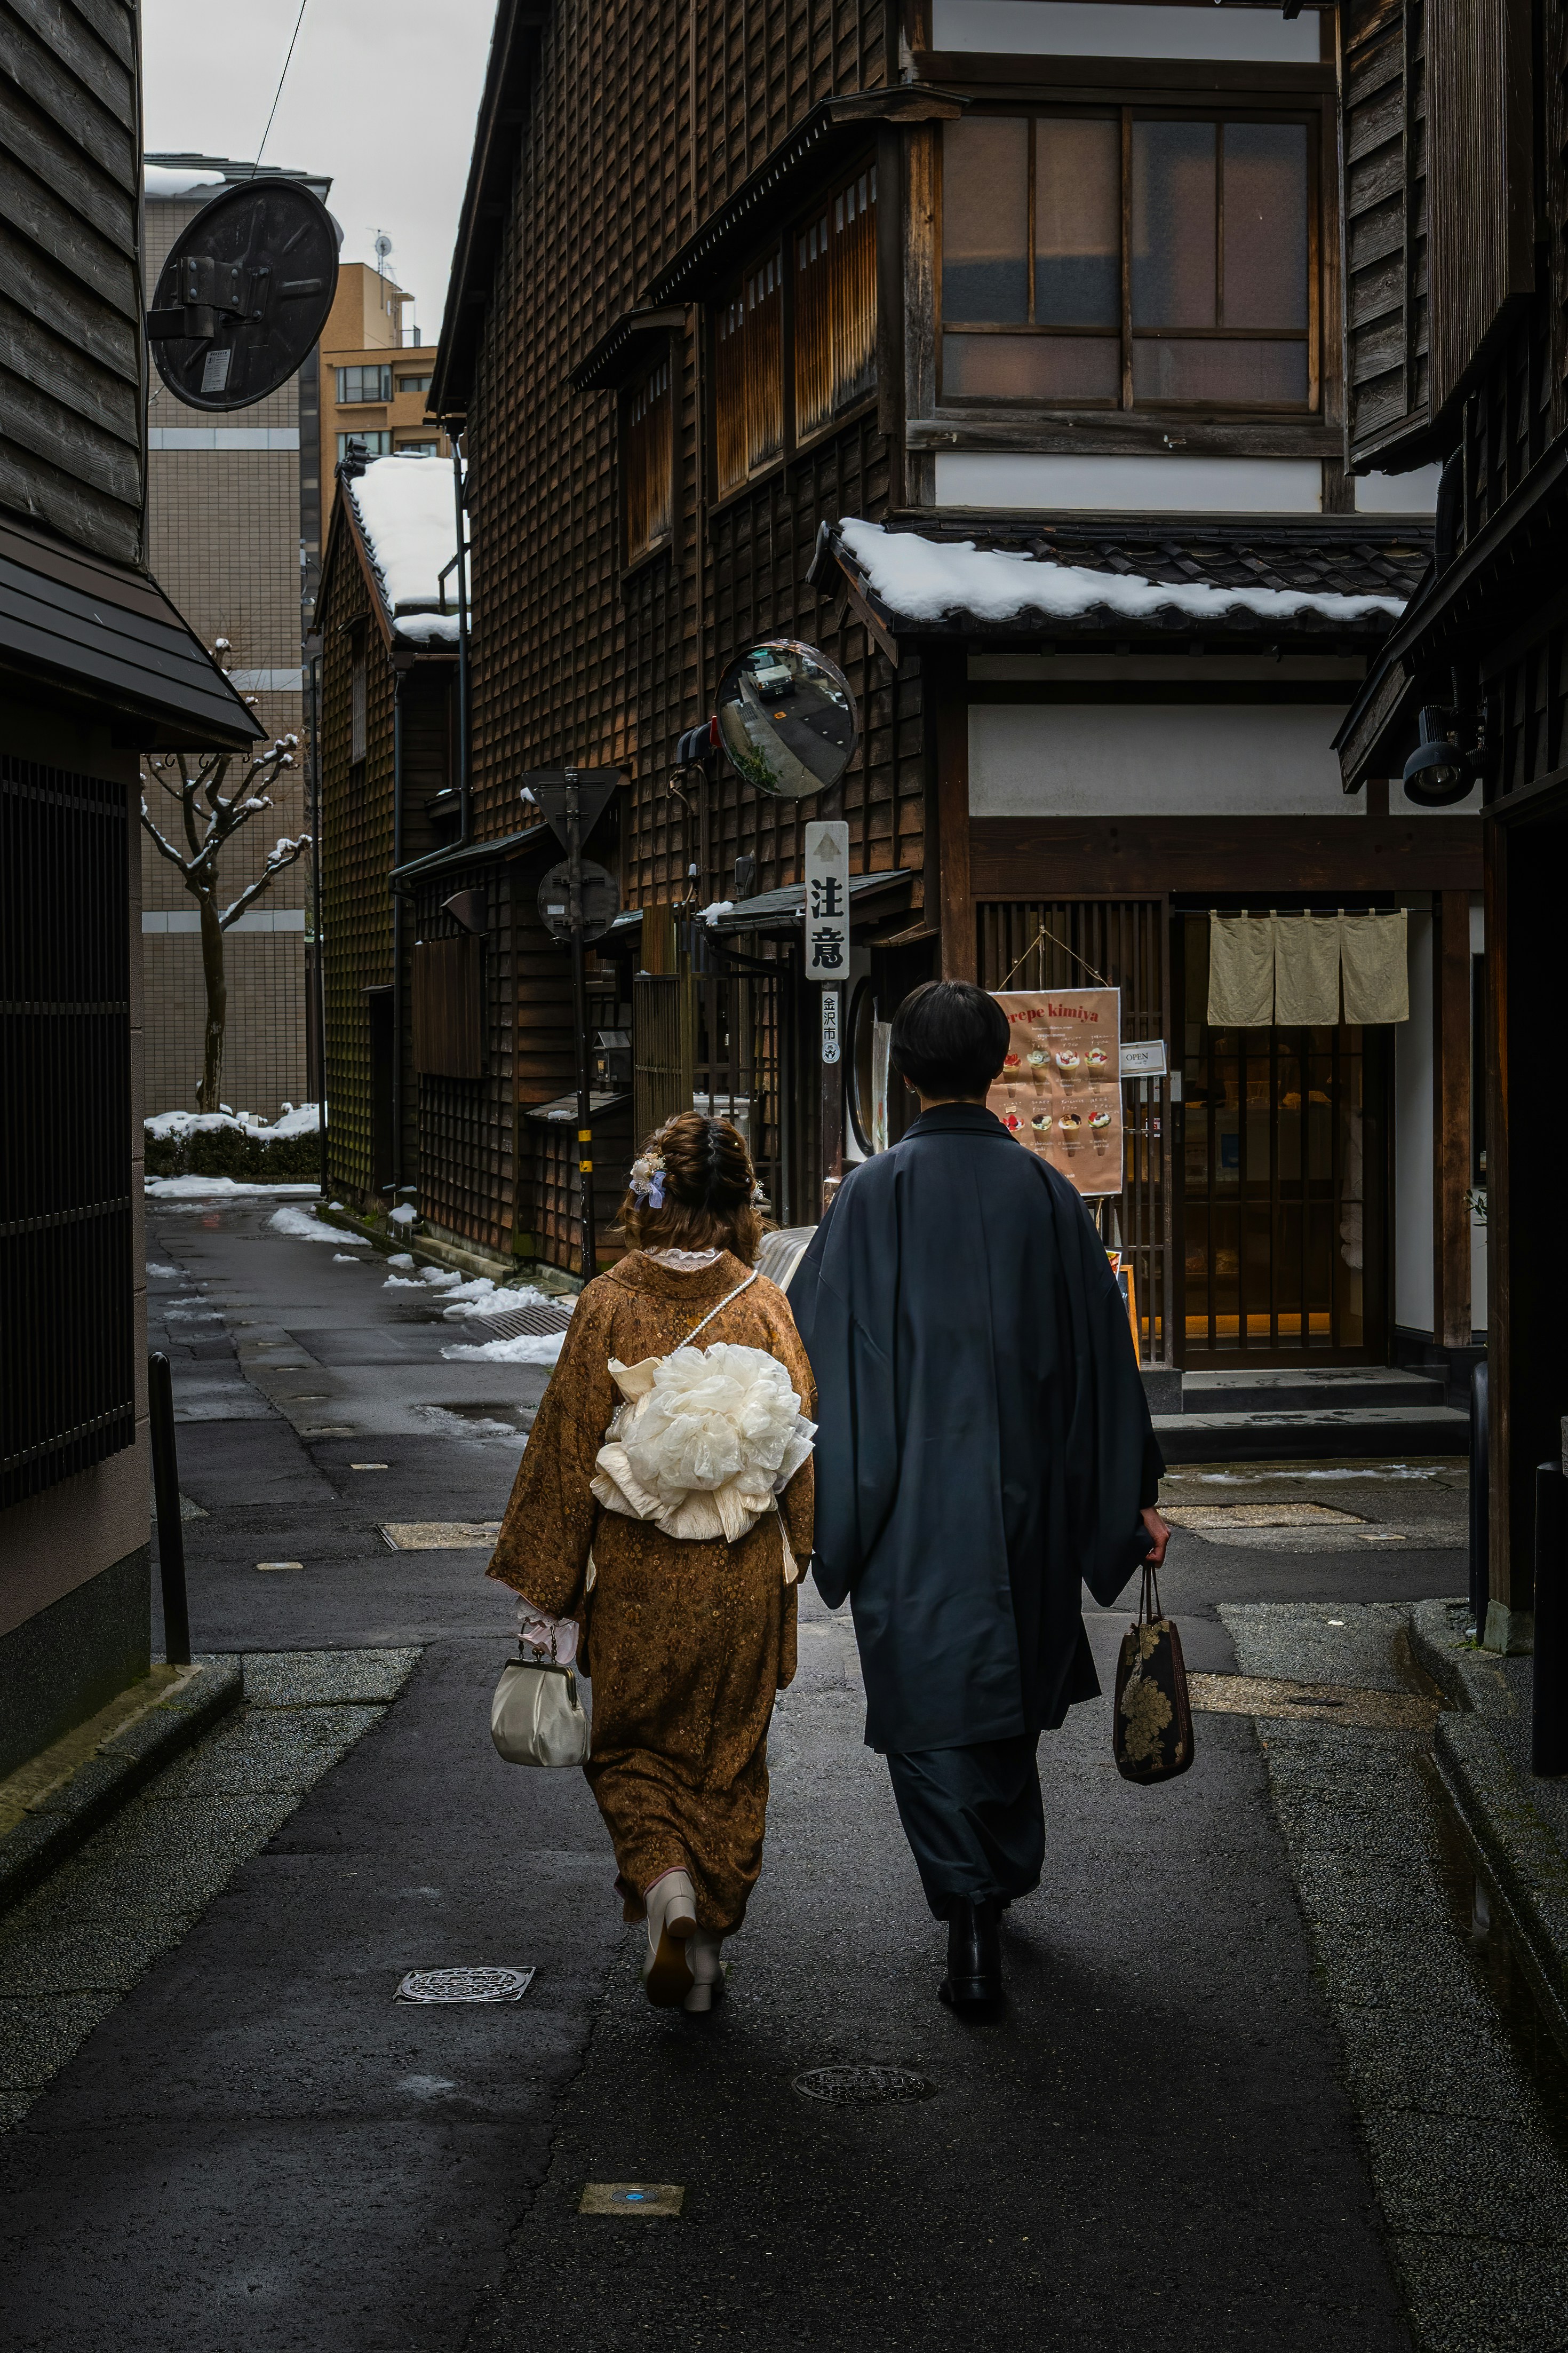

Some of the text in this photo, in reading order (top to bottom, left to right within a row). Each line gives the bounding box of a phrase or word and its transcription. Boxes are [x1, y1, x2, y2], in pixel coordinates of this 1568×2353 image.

[811, 877, 845, 969] 注意
[823, 997, 836, 1040] 金沢市
[1048, 1003, 1099, 1023] kimiya
[1126, 1052, 1149, 1061] OPEN
